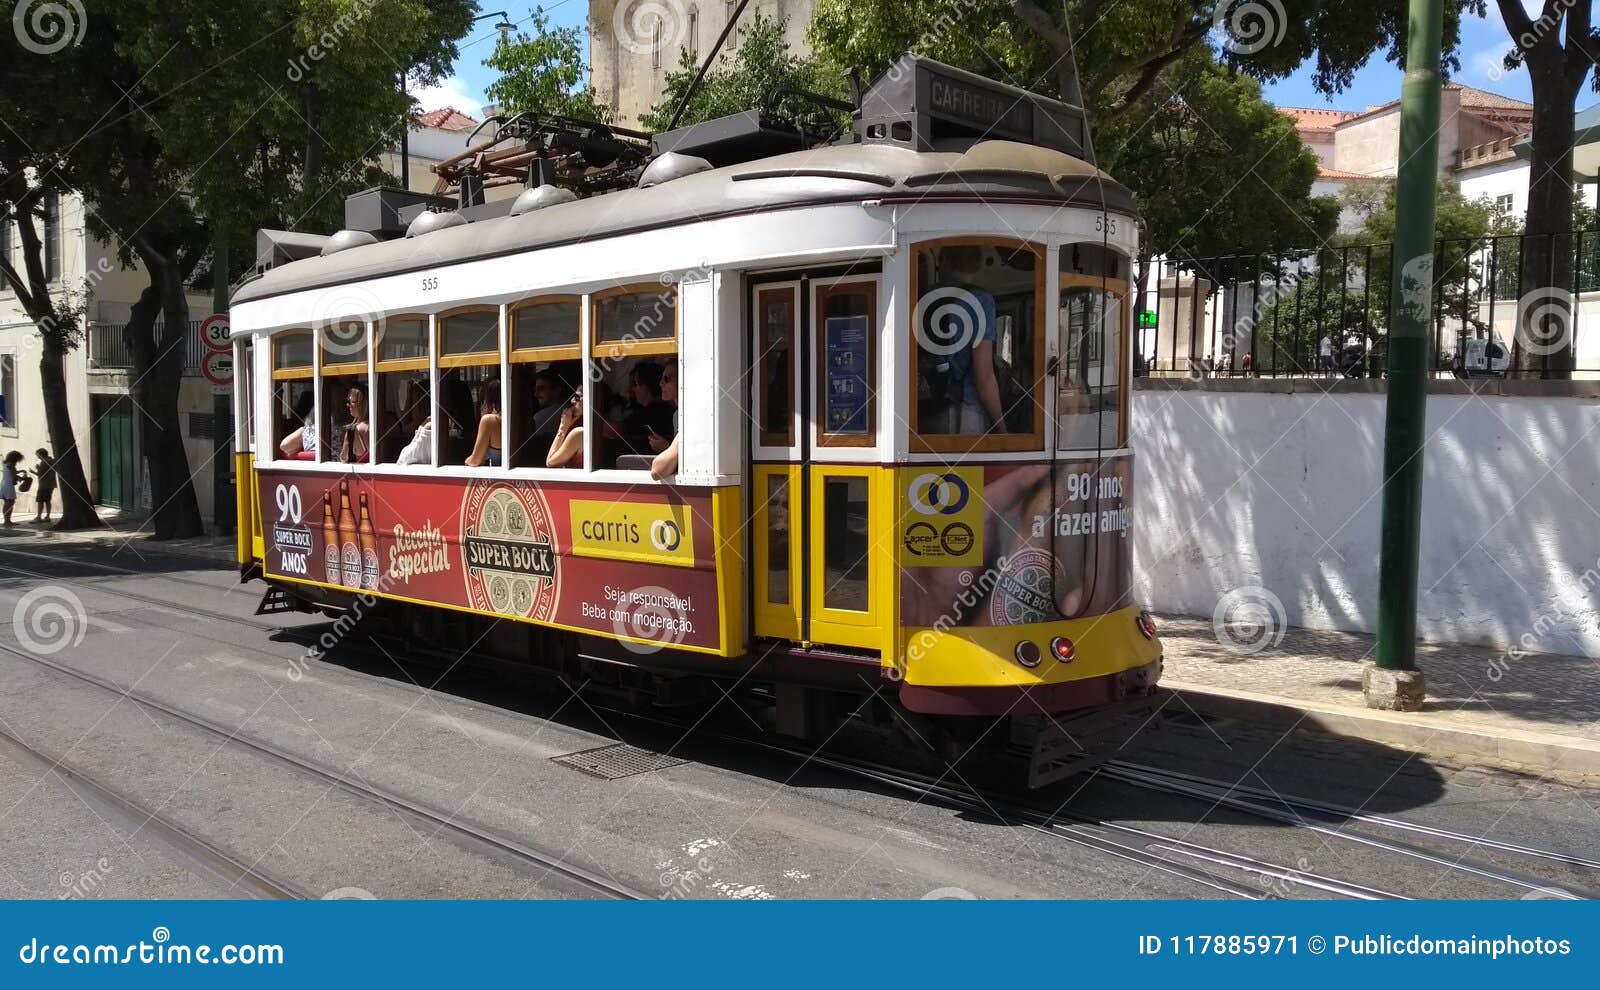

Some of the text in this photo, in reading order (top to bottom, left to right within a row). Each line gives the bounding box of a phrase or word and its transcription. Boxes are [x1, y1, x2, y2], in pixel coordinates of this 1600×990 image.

[1096, 216, 1116, 235] 555
[422, 277, 438, 291] 555
[210, 326, 231, 340] 30
[1067, 472, 1123, 501] 90 anos
[276, 483, 302, 524] 90
[394, 518, 441, 553] Receita
[581, 515, 640, 544] carris
[1032, 515, 1045, 538] a
[1054, 507, 1098, 537] fazer
[275, 532, 311, 546] SUPER BOCK
[281, 551, 307, 575] ANOS
[389, 535, 451, 585] Especial
[469, 541, 550, 573] SUPER BOCK
[604, 585, 695, 612] Seja responsável.
[1002, 576, 1032, 606] SUPER
[582, 601, 696, 635] Beba com moderação.
